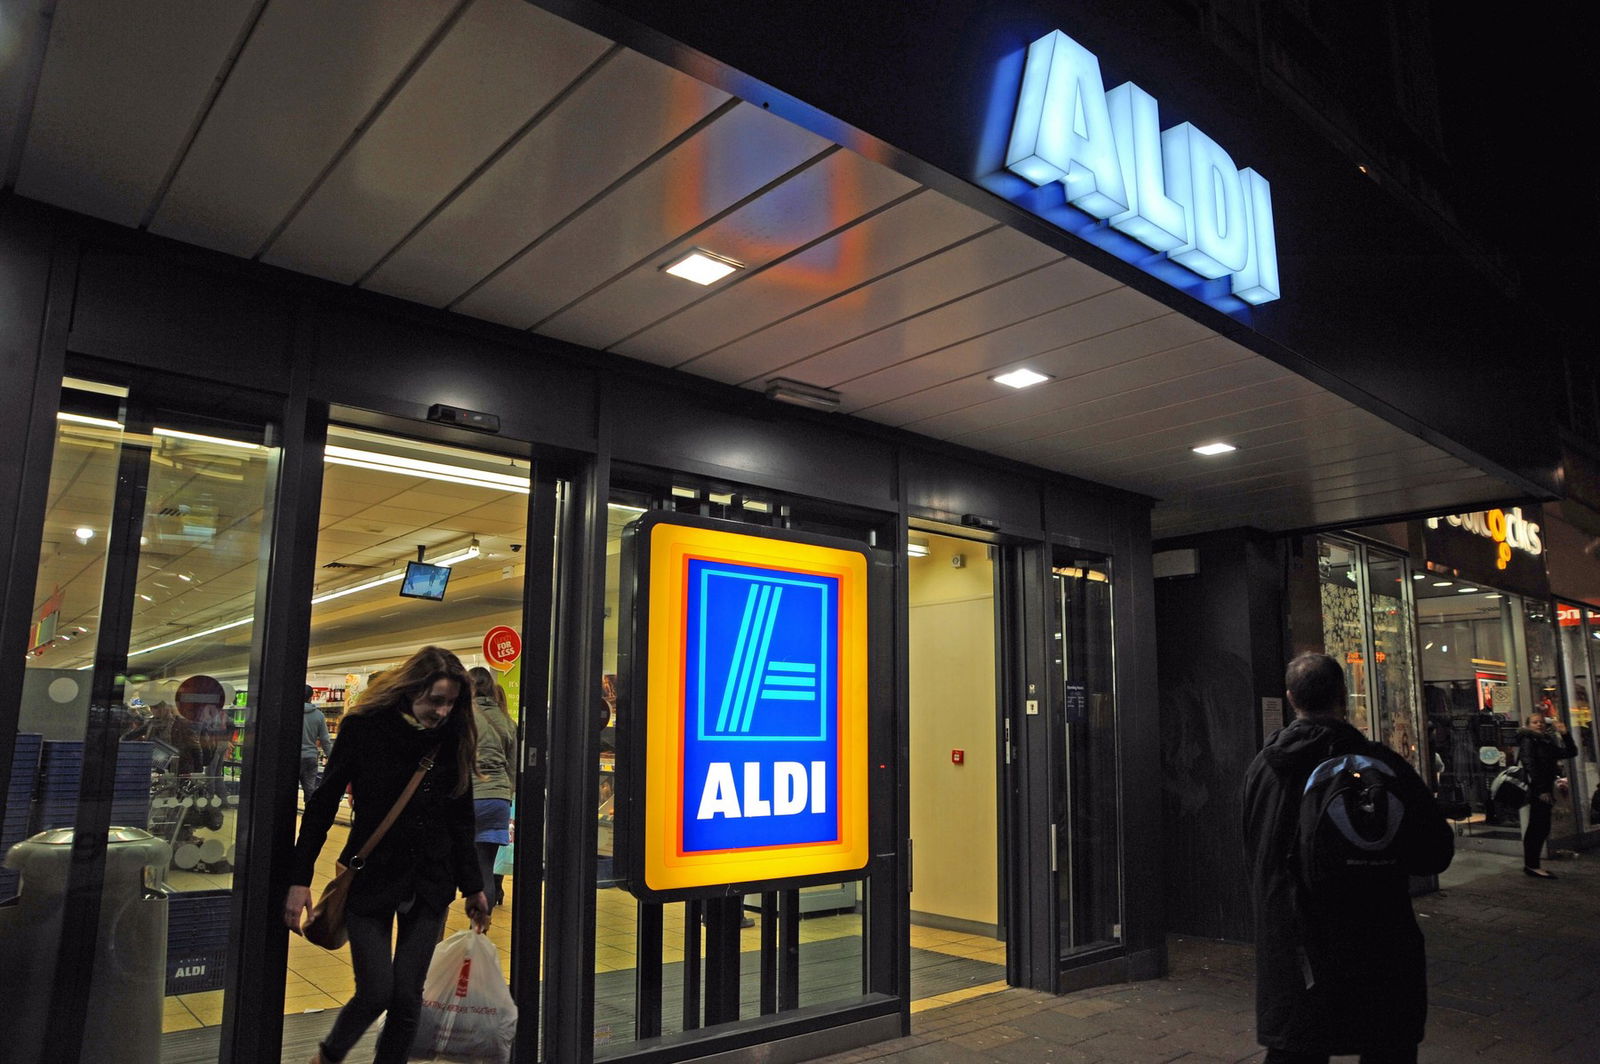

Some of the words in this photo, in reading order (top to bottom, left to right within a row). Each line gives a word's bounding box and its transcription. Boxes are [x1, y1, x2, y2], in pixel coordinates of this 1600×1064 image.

[1006, 29, 1280, 306] ALDI
[497, 641, 512, 651] FOR
[497, 648, 515, 658] LESS
[696, 761, 827, 820] ALDI
[175, 965, 206, 978] ALDI
